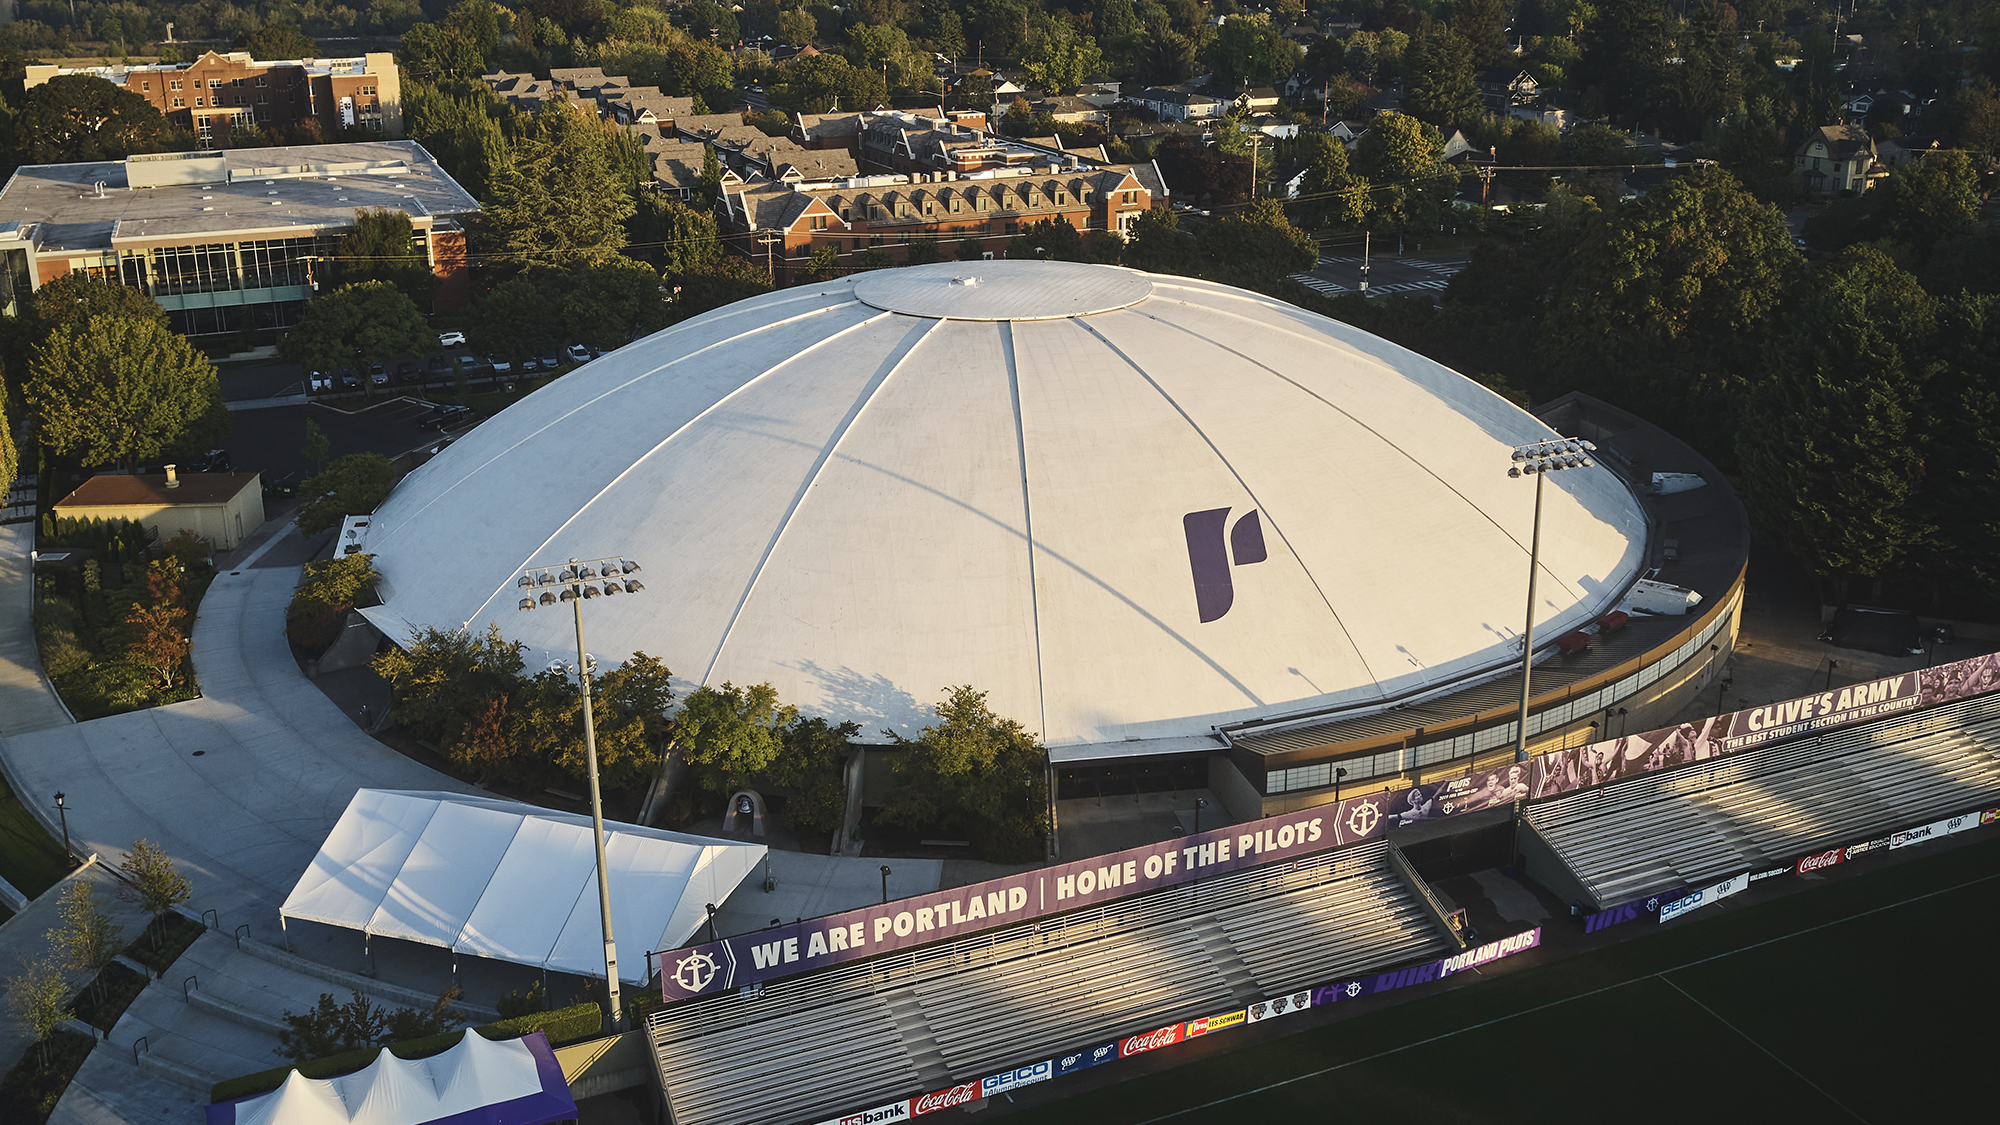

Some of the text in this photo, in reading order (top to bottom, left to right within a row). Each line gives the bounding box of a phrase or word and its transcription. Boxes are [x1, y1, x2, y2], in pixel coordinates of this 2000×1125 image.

[1726, 695, 1919, 749] THE BEST STUDENT SECTION IN THE COUNTRY
[1749, 676, 1905, 731] CLIVE'S ARMY
[1447, 777, 1471, 792] PILOTS
[1056, 817, 1323, 901] HOME OF THE PILOTS
[1661, 891, 1703, 915] GEICO
[751, 886, 1028, 970] WE ARE PORTLAND
[1440, 930, 1535, 977] PORTLAND PILOTS
[1208, 1019, 1219, 1028] LES
[1219, 1013, 1244, 1025] SCHWAB
[983, 1062, 1049, 1090] GEICO
